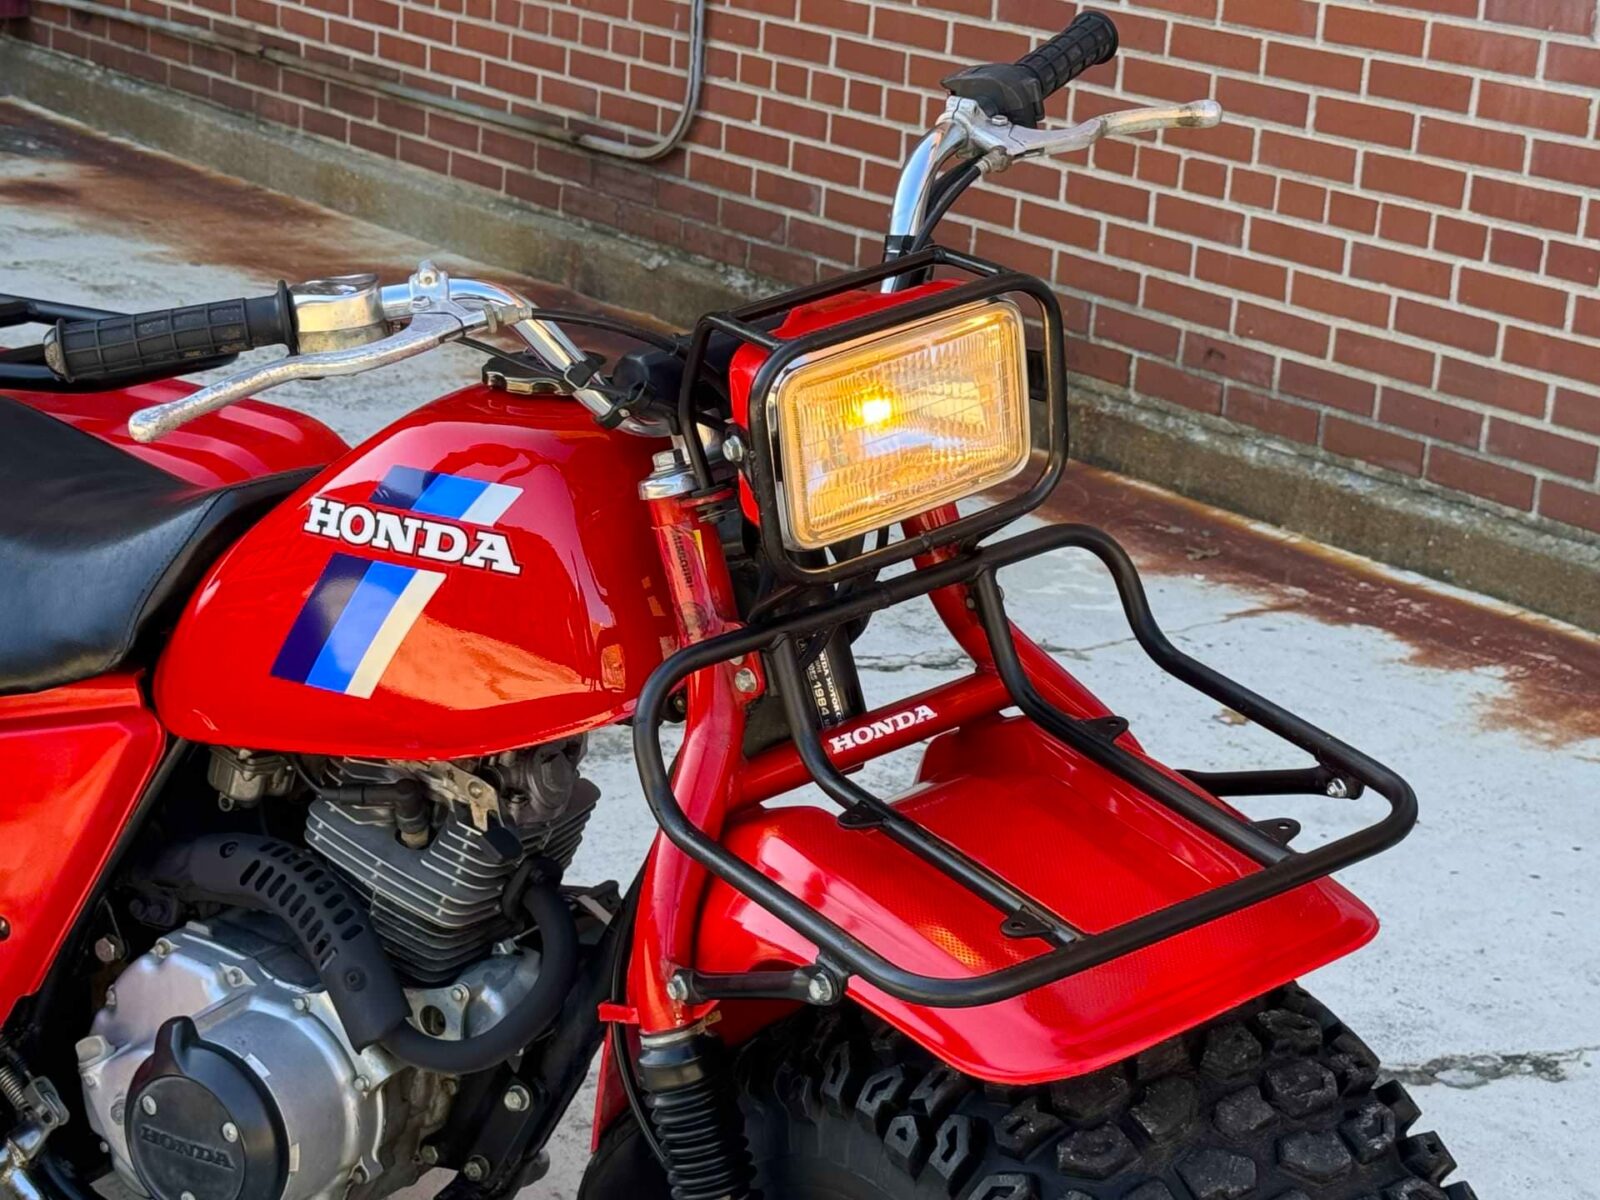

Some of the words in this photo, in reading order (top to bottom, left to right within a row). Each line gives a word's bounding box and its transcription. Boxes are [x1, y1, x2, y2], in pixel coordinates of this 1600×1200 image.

[302, 497, 522, 575] HONDA
[813, 681, 830, 716] 1984
[828, 704, 938, 755] HONDA
[140, 1124, 236, 1171] HONDA
